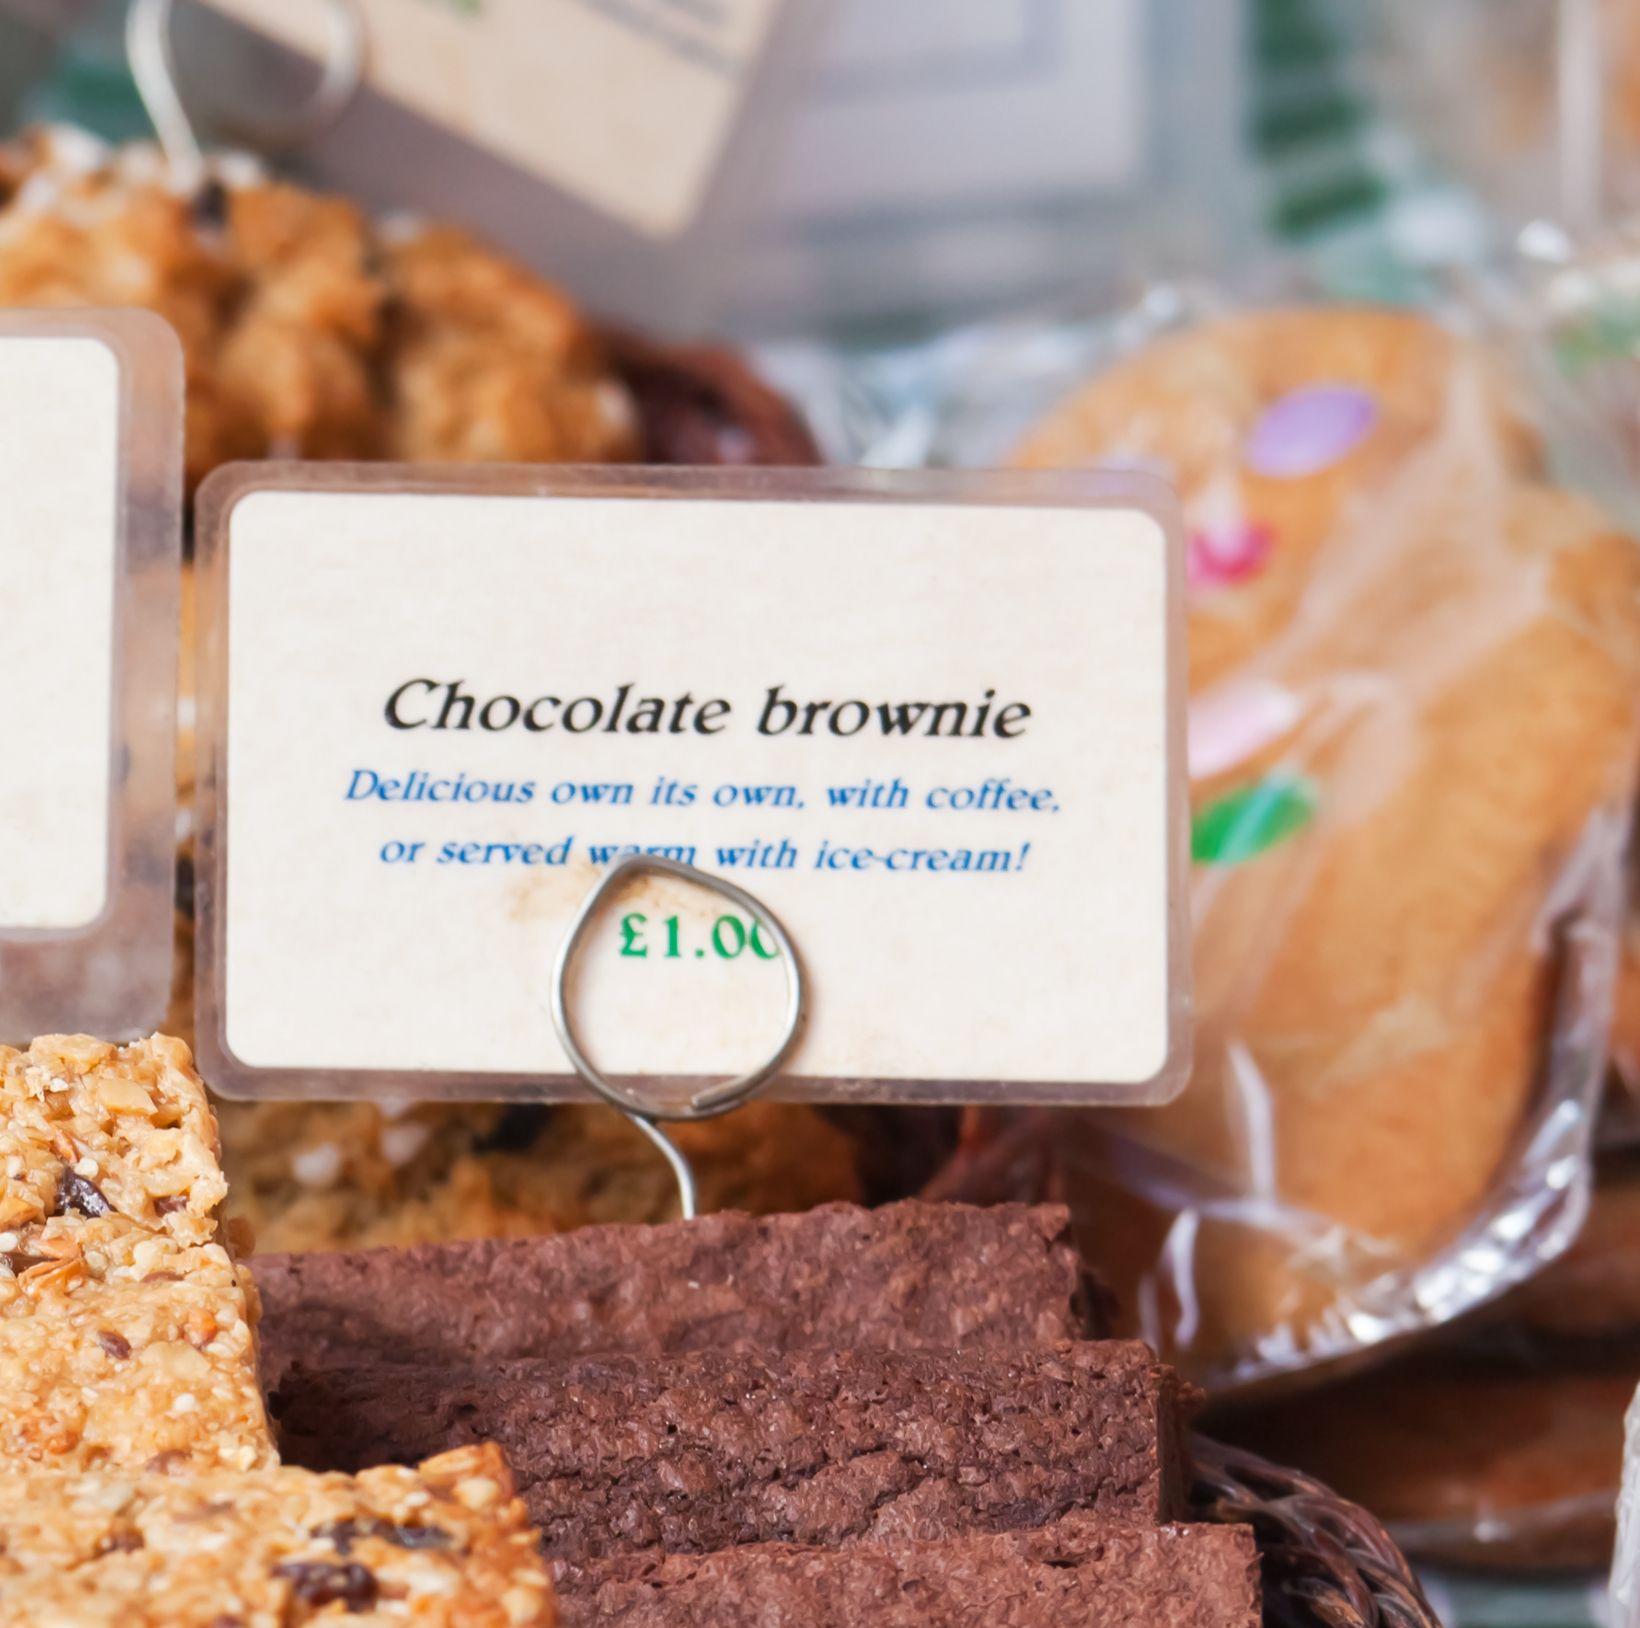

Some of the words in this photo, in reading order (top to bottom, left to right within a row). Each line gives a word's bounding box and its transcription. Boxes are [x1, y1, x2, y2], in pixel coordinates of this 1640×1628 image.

[384, 678, 732, 736] Chocolate
[756, 685, 1032, 739] brownie
[345, 769, 536, 804] Delicious
[550, 782, 634, 805] own
[650, 776, 698, 806] its
[712, 785, 804, 809] own,
[827, 778, 909, 808] with
[925, 778, 1059, 812] coffee,
[378, 840, 426, 864] or
[436, 835, 574, 866] served
[714, 838, 798, 869] with
[814, 840, 1031, 872] ice-cream!
